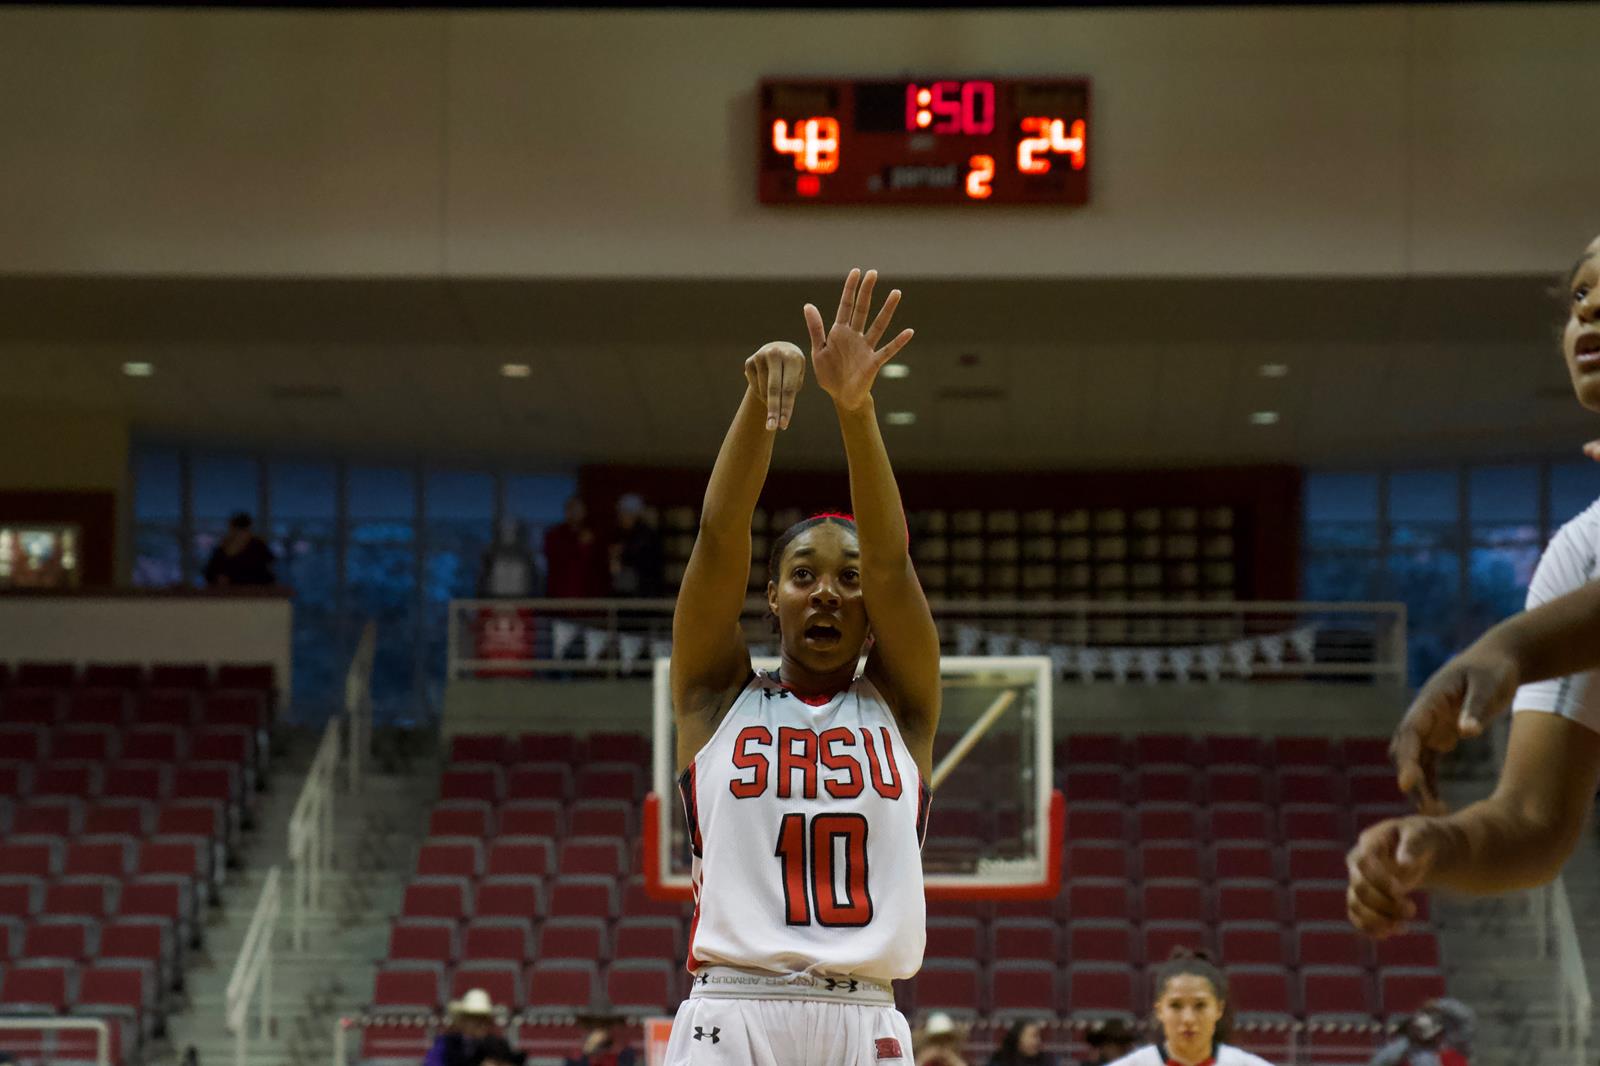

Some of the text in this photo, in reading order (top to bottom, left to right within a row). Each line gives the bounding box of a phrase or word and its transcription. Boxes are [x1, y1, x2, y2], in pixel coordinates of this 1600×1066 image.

[773, 116, 840, 174] 48
[1016, 116, 1085, 174] 24
[965, 155, 995, 198] 2
[729, 726, 902, 800] SRSU
[774, 813, 873, 928] 10
[711, 975, 760, 986] ARMOUR
